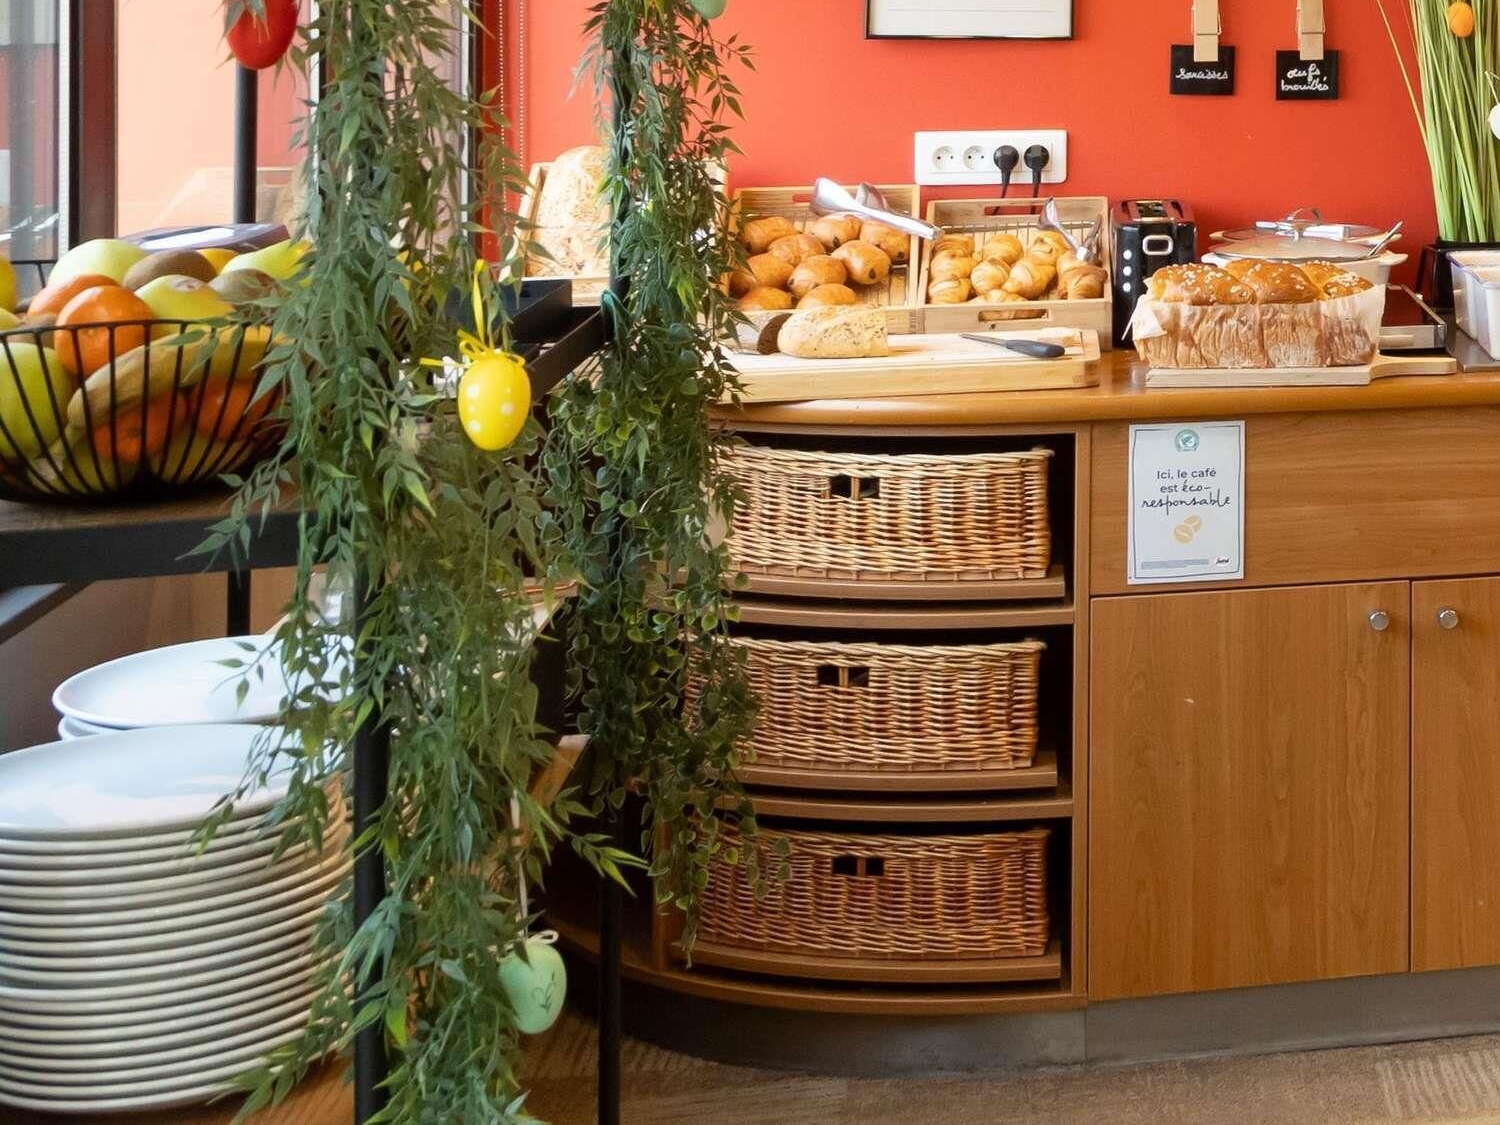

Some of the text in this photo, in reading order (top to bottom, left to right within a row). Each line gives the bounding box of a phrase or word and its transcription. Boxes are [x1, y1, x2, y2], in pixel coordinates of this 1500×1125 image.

[1157, 467, 1217, 480] Ici, le café
[1160, 484, 1178, 493] est
[1141, 488, 1230, 516] responsable
